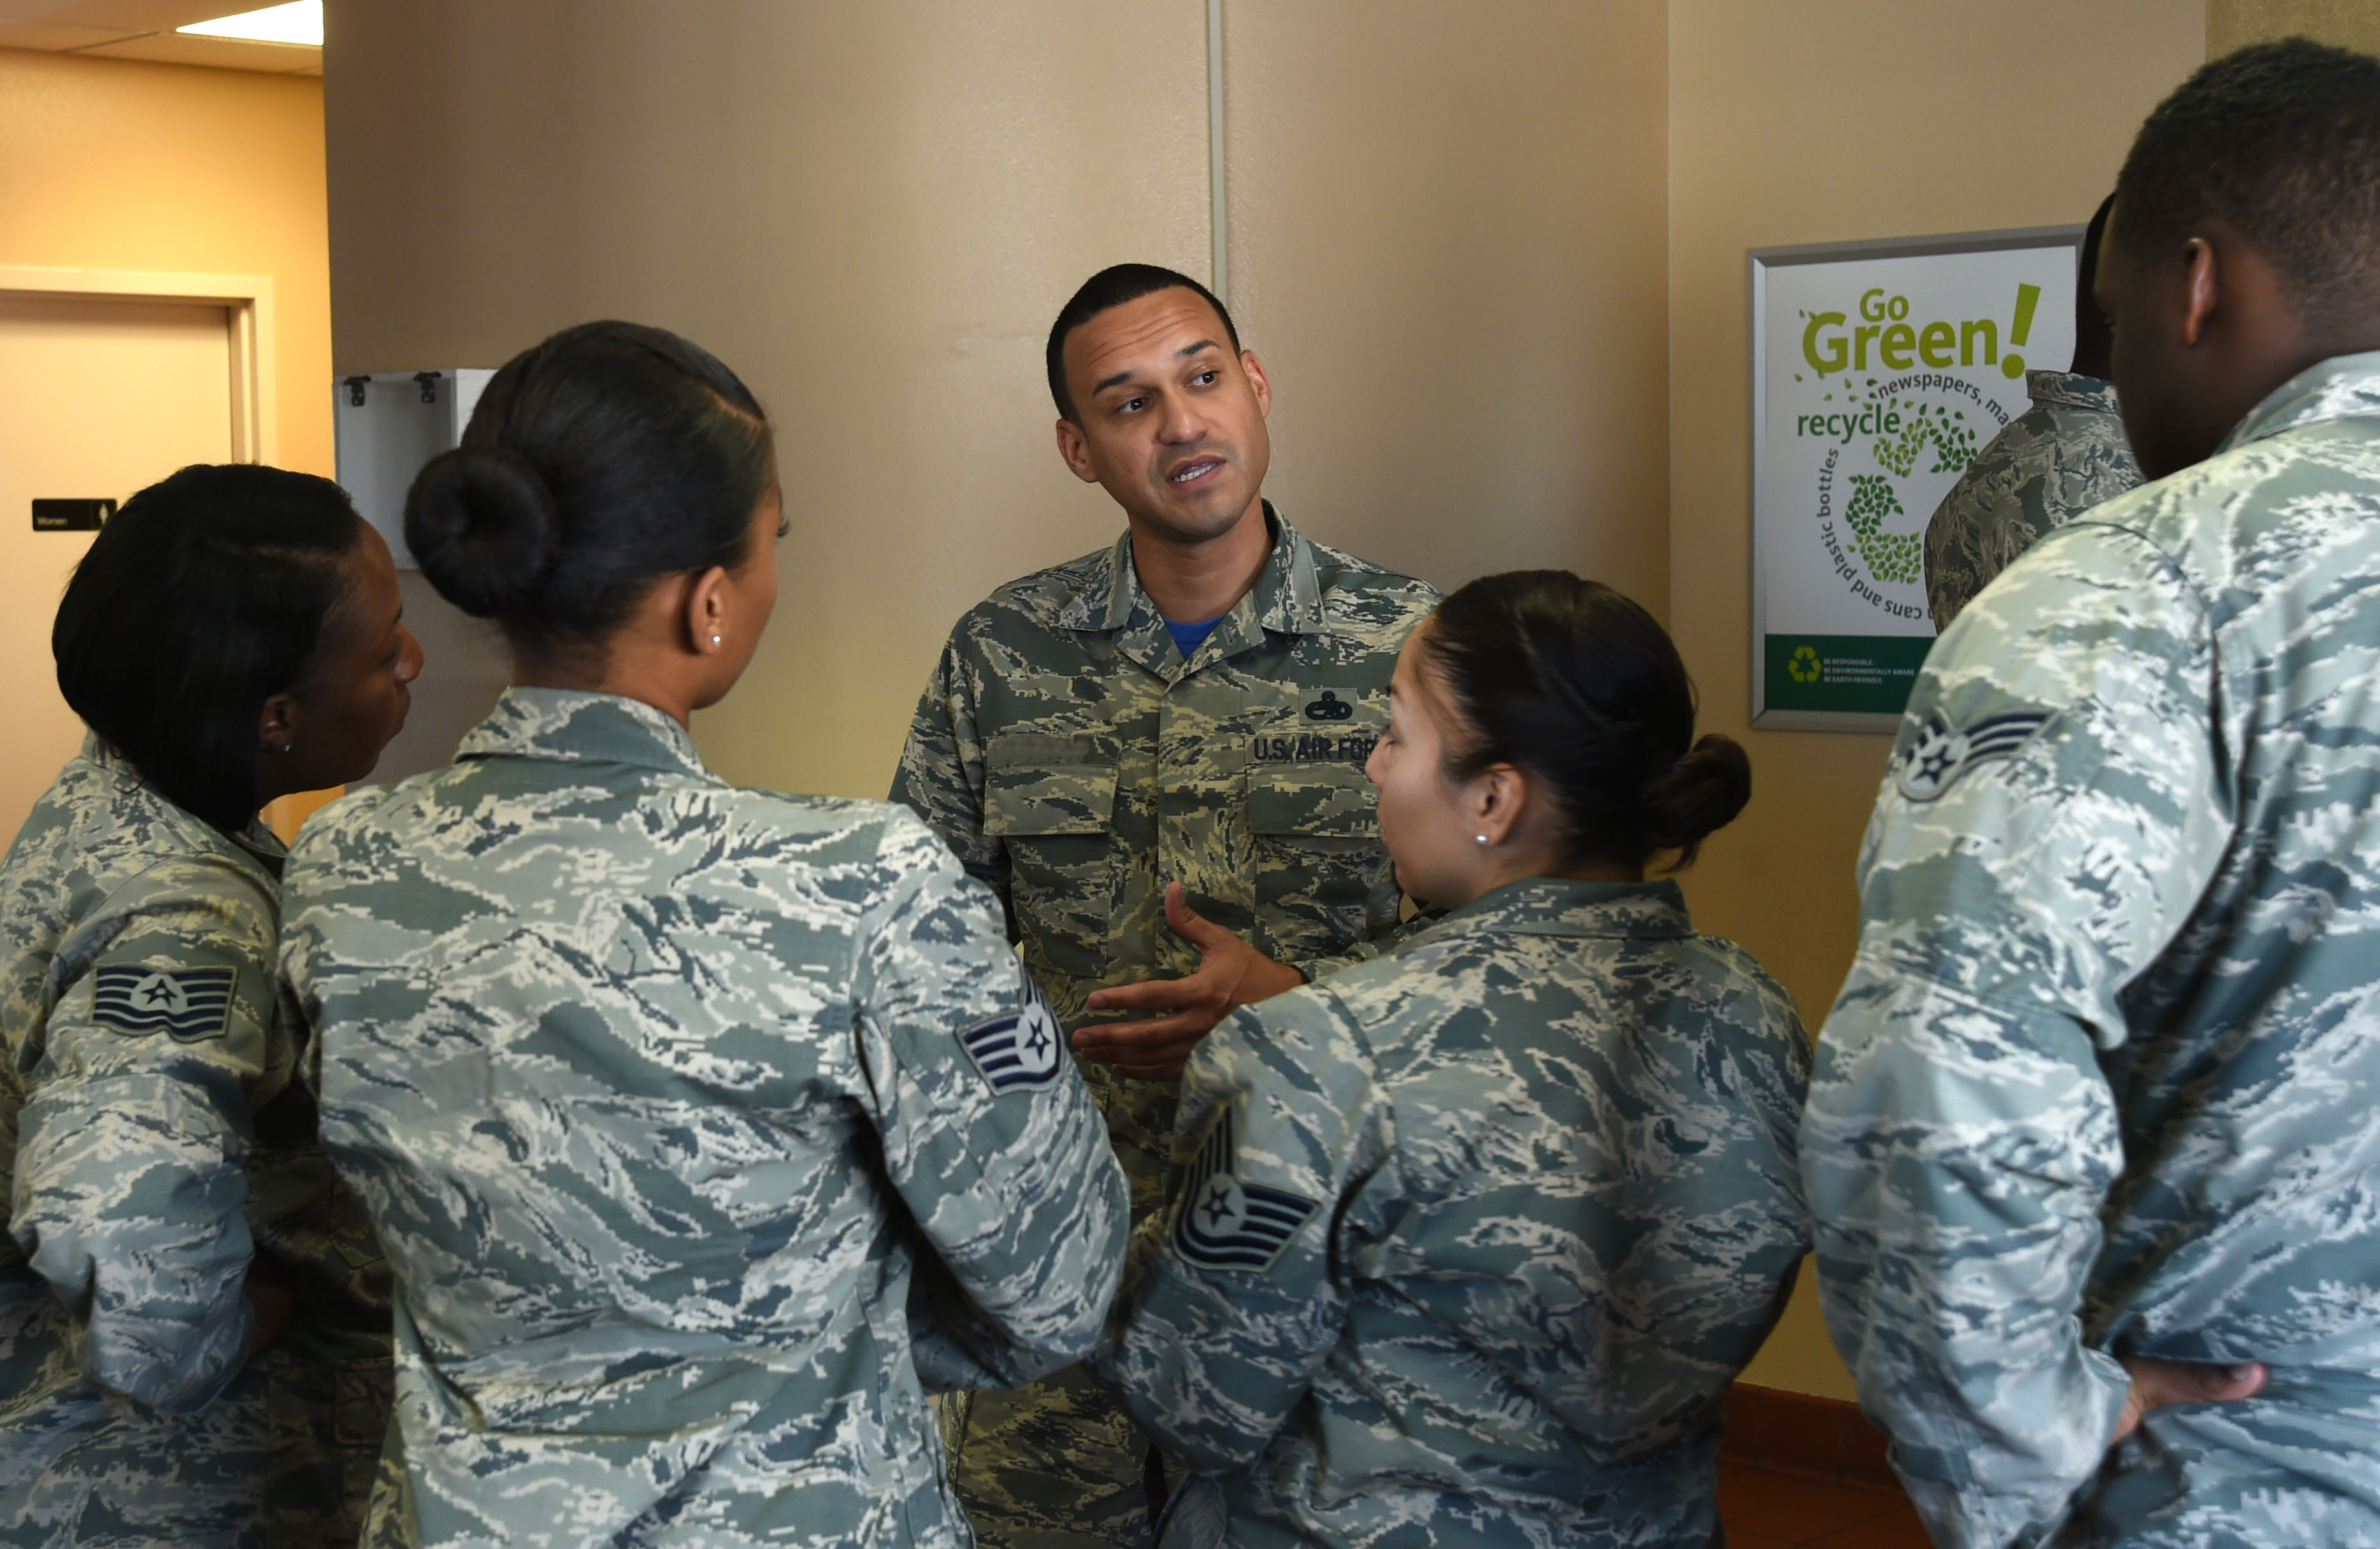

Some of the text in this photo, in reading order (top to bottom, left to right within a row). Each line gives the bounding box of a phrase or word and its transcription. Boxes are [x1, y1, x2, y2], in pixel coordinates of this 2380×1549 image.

[1860, 288, 1910, 322] Go
[1802, 283, 2041, 379] Green!
[1878, 373, 1982, 406] newspapers,
[1797, 404, 1900, 444] recycle
[36, 517, 68, 525] Women
[1817, 448, 1923, 620] cans and plastic bottles
[1296, 735, 1333, 760] AIR
